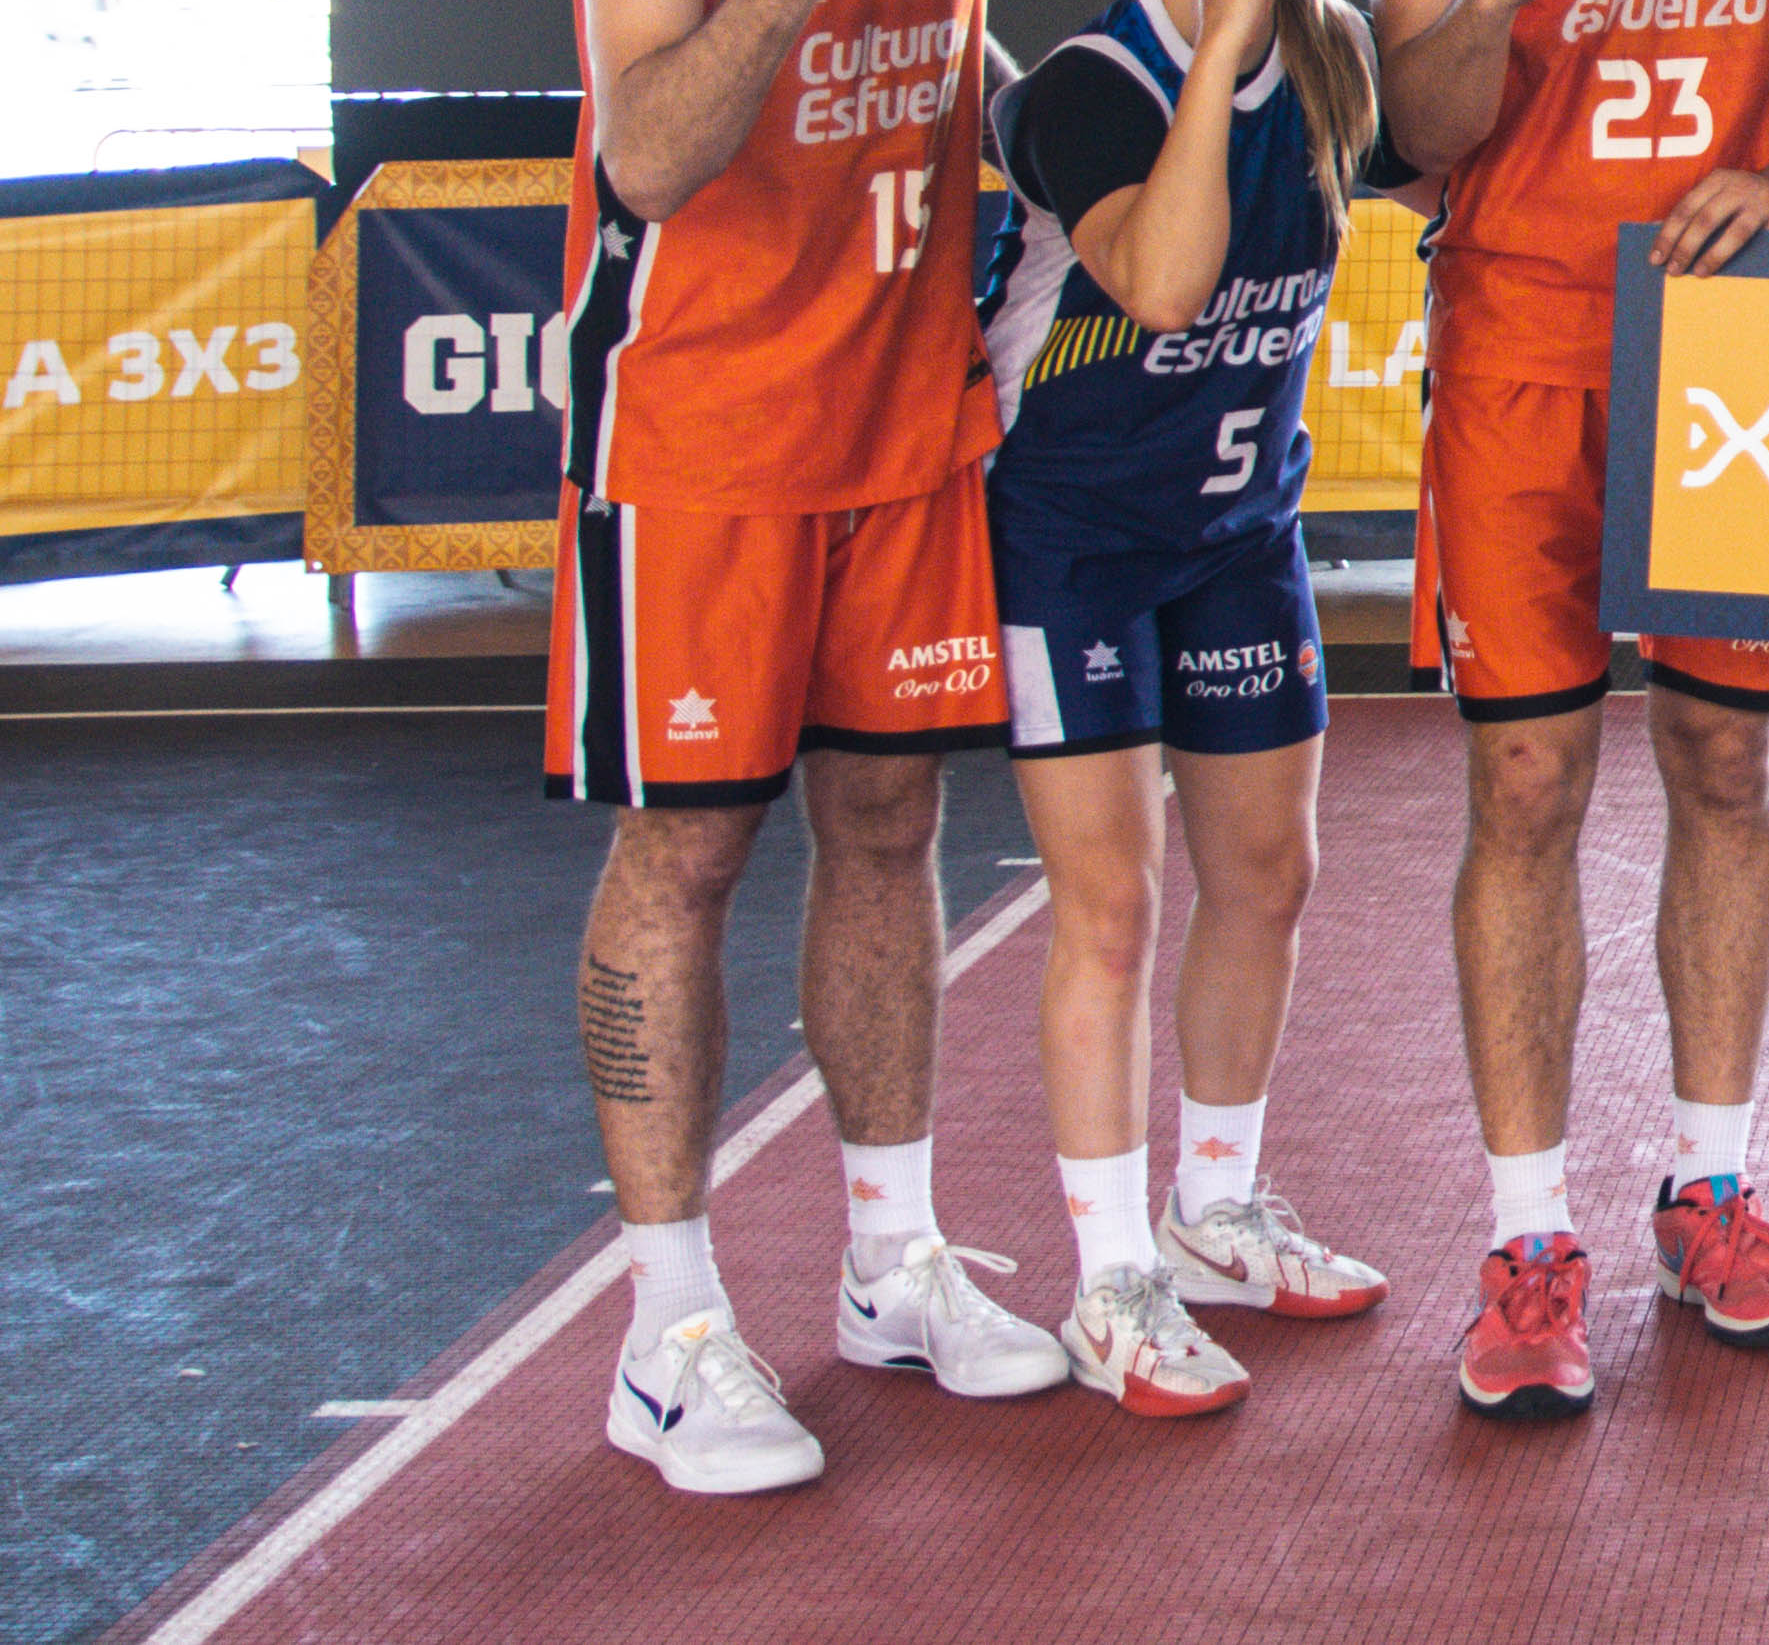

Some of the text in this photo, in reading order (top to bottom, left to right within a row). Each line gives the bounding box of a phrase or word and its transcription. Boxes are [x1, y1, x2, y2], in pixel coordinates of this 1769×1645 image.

[1592, 56, 1714, 160] 23
[869, 164, 935, 274] 15
[1194, 268, 1318, 327] ultura
[2, 322, 301, 410] A 3X3
[1200, 407, 1267, 495] 5
[888, 635, 997, 672] AMSTEL
[1177, 639, 1288, 673] AMSTEL
[667, 727, 720, 742] luanvi
